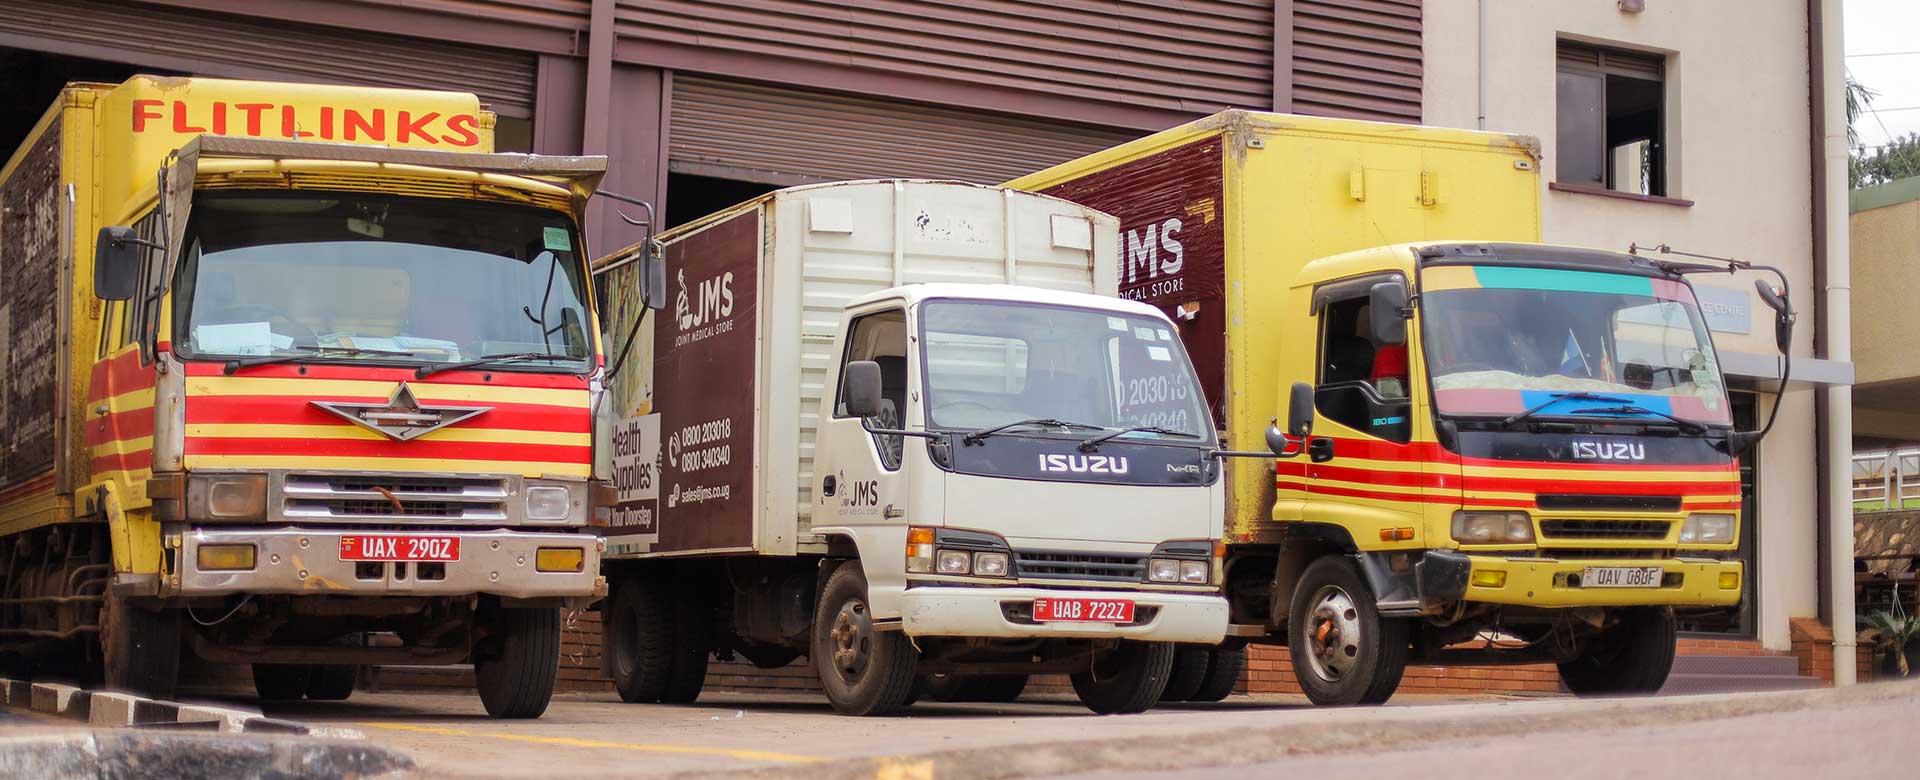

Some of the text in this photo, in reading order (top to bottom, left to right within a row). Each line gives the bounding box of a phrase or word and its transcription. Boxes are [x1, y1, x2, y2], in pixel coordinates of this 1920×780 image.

[132, 99, 480, 147] FLITLINKS
[693, 271, 734, 327] JMS
[1119, 277, 1184, 301] DICAL STORE
[691, 325, 715, 342] MEDICAL
[715, 319, 734, 335] STORE
[611, 421, 641, 458] Health
[682, 417, 731, 447] 0800 203018
[681, 444, 731, 473] 0800 340340
[1572, 441, 1645, 460] ISUZU
[1039, 453, 1129, 474] ISUZU
[611, 456, 652, 499] Supplies
[850, 480, 879, 506] JMS
[611, 507, 625, 528] Your
[625, 505, 652, 529] Doorstep
[362, 538, 451, 558] UAX 290Z
[1598, 569, 1621, 585] UAV
[1053, 600, 1125, 619] UAB 722Z
